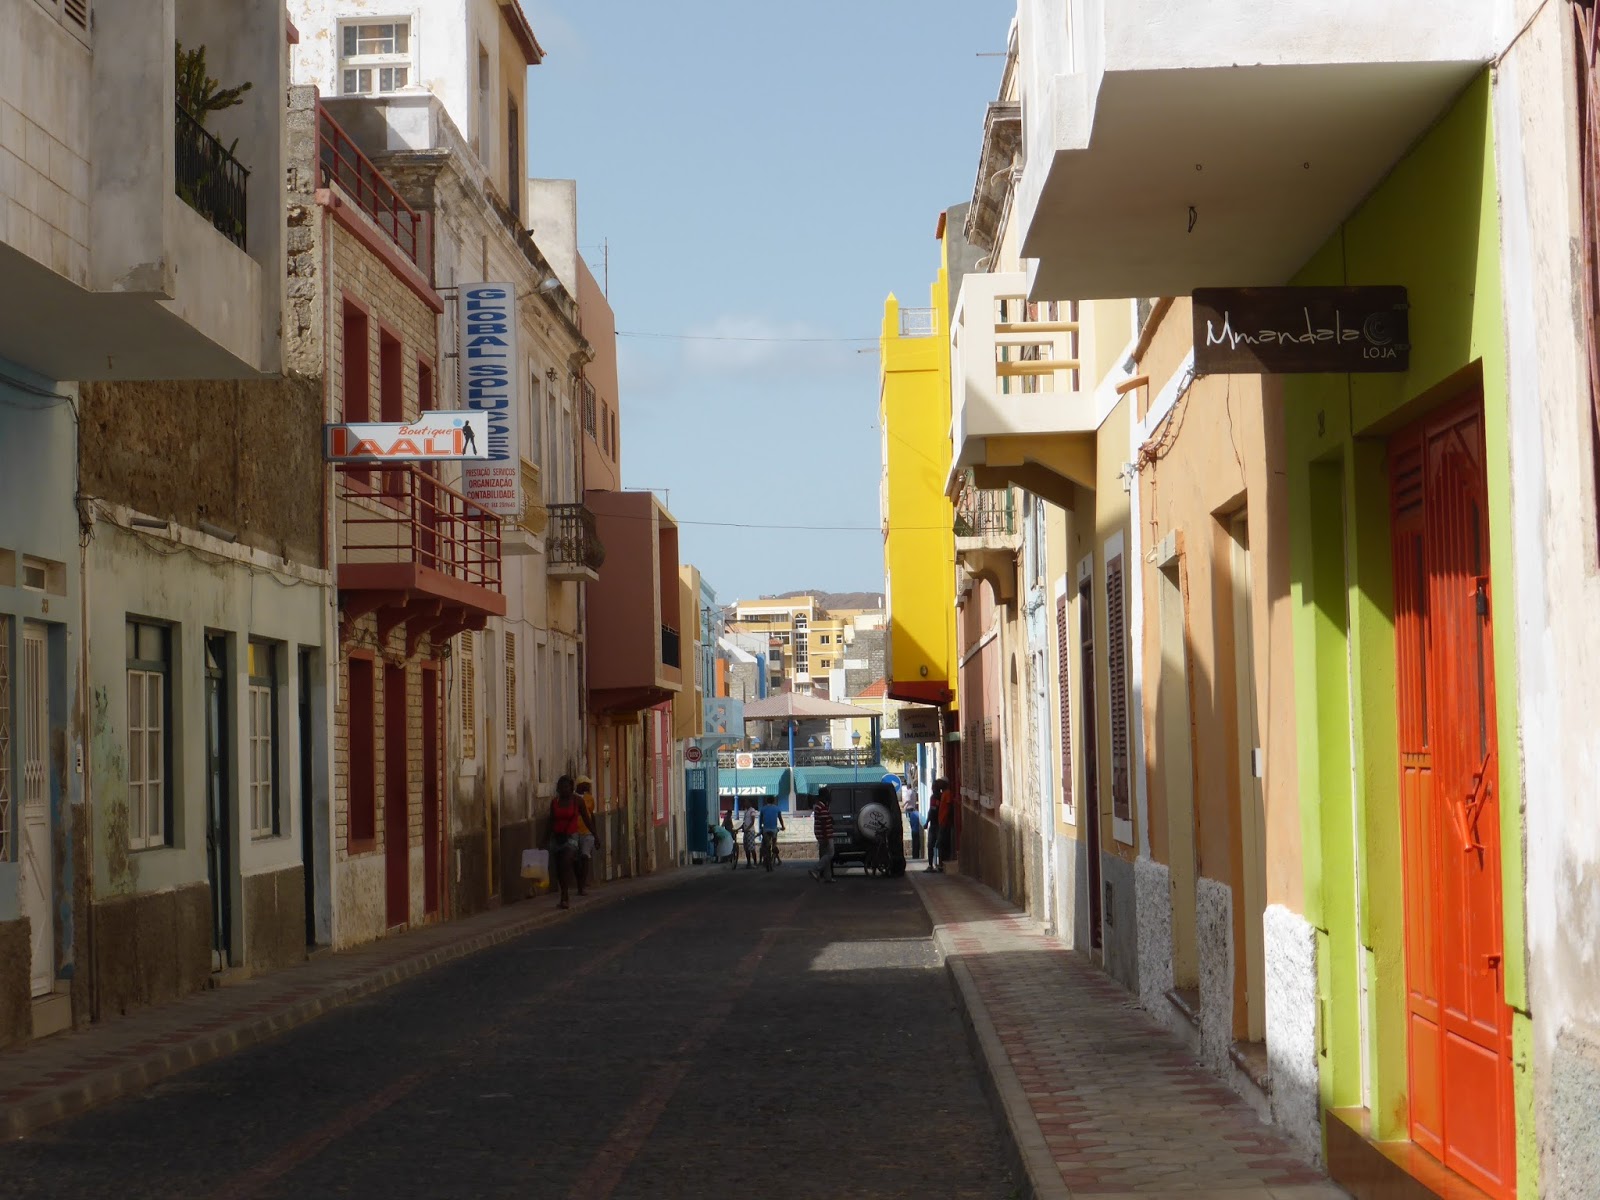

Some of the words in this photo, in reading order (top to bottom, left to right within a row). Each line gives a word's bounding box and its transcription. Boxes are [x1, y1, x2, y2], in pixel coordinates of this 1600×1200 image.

[466, 289, 509, 358] GLOBAL
[1206, 306, 1360, 350] Mmandala
[1363, 347, 1396, 359] LOJA
[398, 426, 452, 438] Boutique
[493, 467, 516, 477] SERVIÇOS
[469, 477, 513, 489] ORGANIZAÇÃO
[467, 490, 515, 500] CONTABILIDADE
[904, 731, 936, 739] IMAGEM
